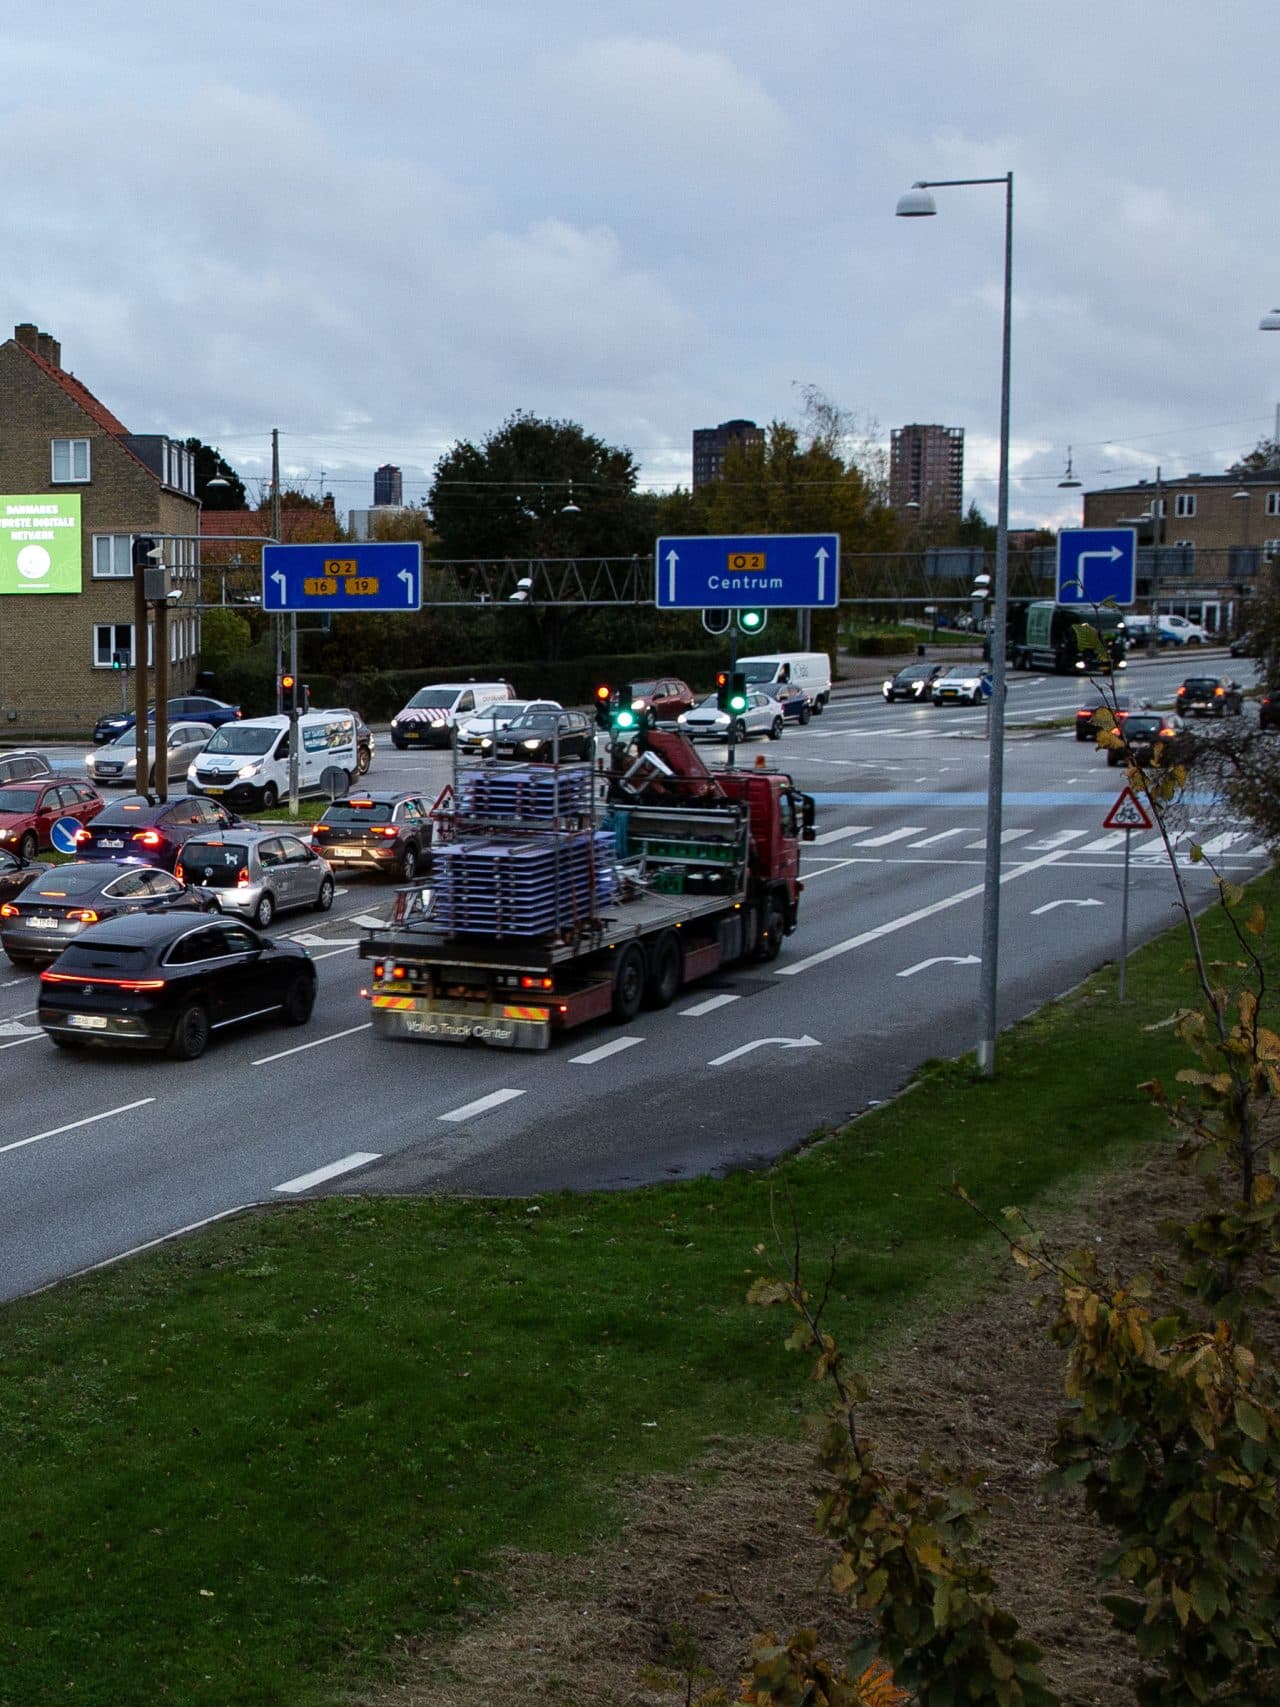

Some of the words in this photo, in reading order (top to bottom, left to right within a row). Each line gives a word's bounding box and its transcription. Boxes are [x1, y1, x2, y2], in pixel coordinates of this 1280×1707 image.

[751, 556, 760, 567] 2
[345, 562, 352, 573] 2
[314, 581, 327, 592] 16
[355, 581, 368, 591] 19
[708, 575, 783, 589] Centrum
[440, 1023, 471, 1036] Truck
[473, 1026, 512, 1039] Center
